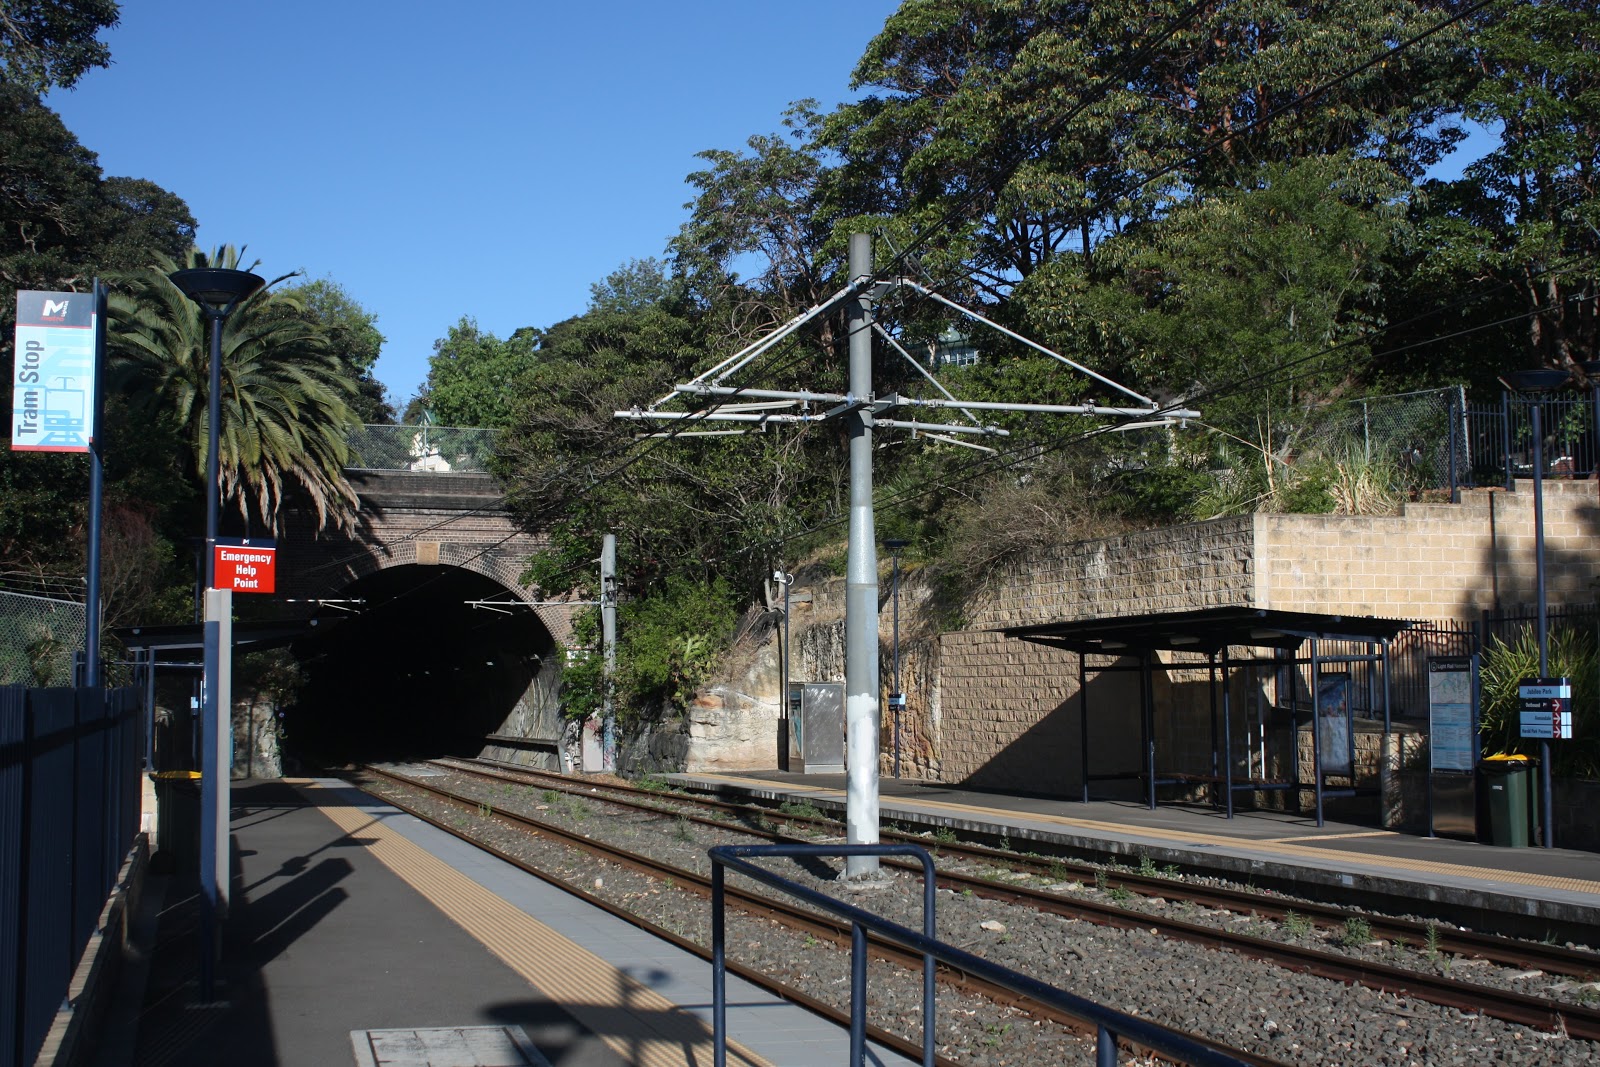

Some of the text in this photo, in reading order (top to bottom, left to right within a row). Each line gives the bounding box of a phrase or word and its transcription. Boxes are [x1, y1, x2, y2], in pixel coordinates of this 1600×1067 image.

[17, 340, 45, 437] Tram Stop
[220, 550, 272, 564] Emergency
[235, 564, 257, 577] Help
[233, 577, 259, 589] Point
